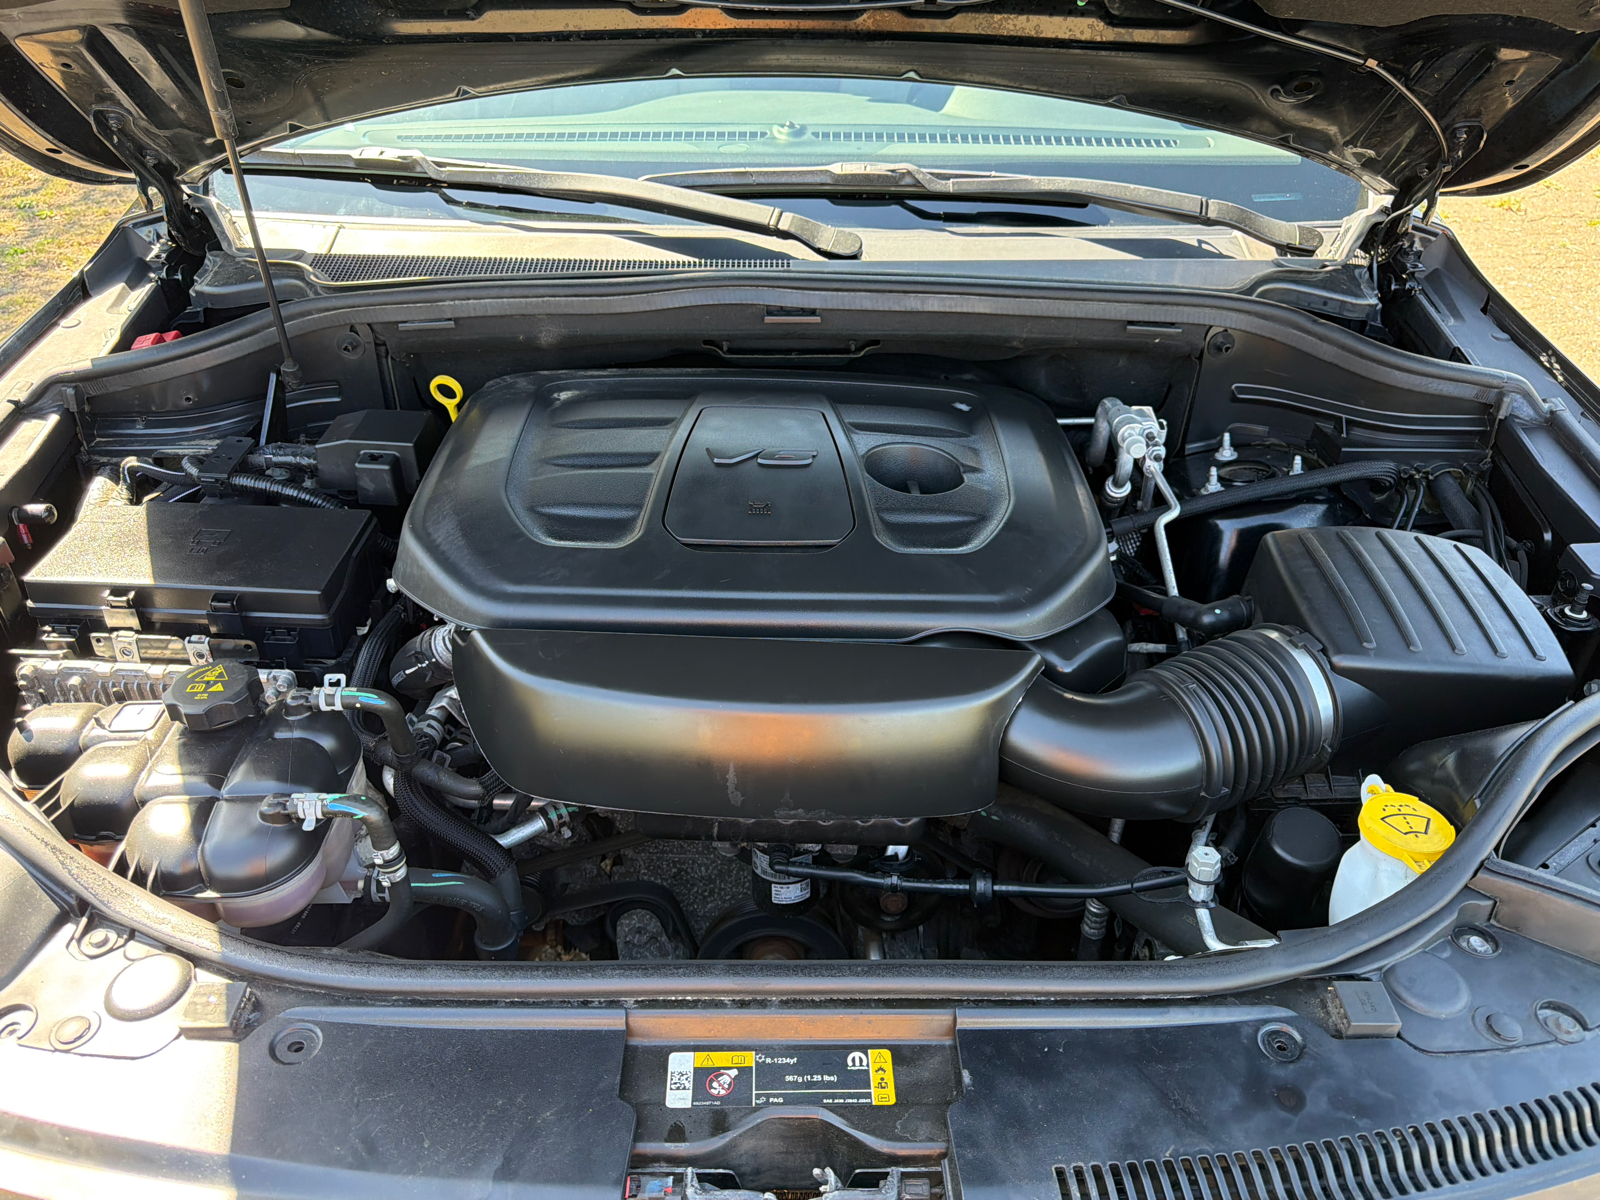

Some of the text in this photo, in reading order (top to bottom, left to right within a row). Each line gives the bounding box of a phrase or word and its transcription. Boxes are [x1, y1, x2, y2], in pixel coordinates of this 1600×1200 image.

[705, 447, 819, 467] V6
[765, 1057, 798, 1065] R-1234yf
[785, 1075, 803, 1083] 567g
[823, 1074, 838, 1082] lbs)
